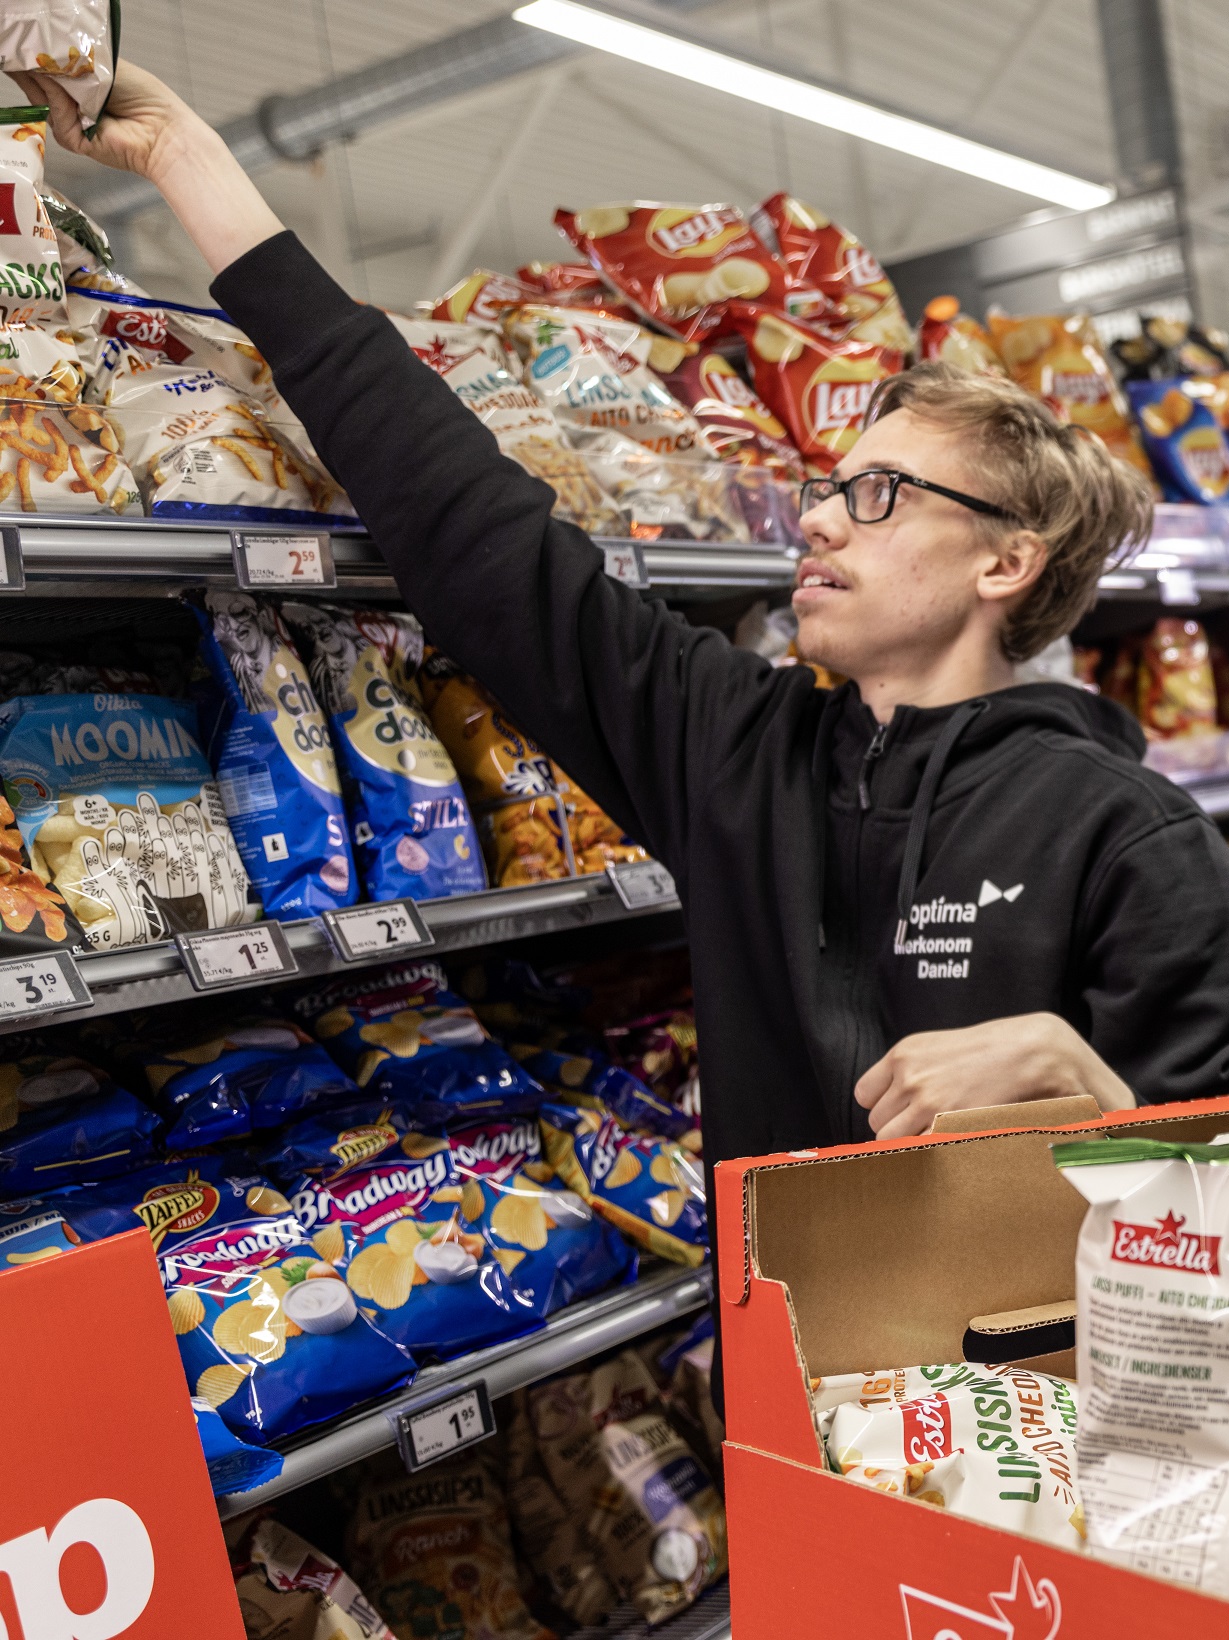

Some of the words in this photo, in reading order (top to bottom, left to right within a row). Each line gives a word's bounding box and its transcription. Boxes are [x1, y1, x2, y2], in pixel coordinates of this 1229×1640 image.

[289, 551, 304, 575] 2
[302, 551, 315, 562] 59
[909, 896, 978, 930] optima
[377, 920, 398, 943] 2
[238, 943, 257, 970] 1
[253, 941, 269, 954] 25
[917, 958, 970, 979] Daniel
[16, 975, 43, 1004] 3
[39, 973, 57, 986] 19
[139, 1190, 202, 1231] TAFFEL
[177, 1210, 205, 1229] SNACKS
[1115, 1226, 1212, 1271] Estrella
